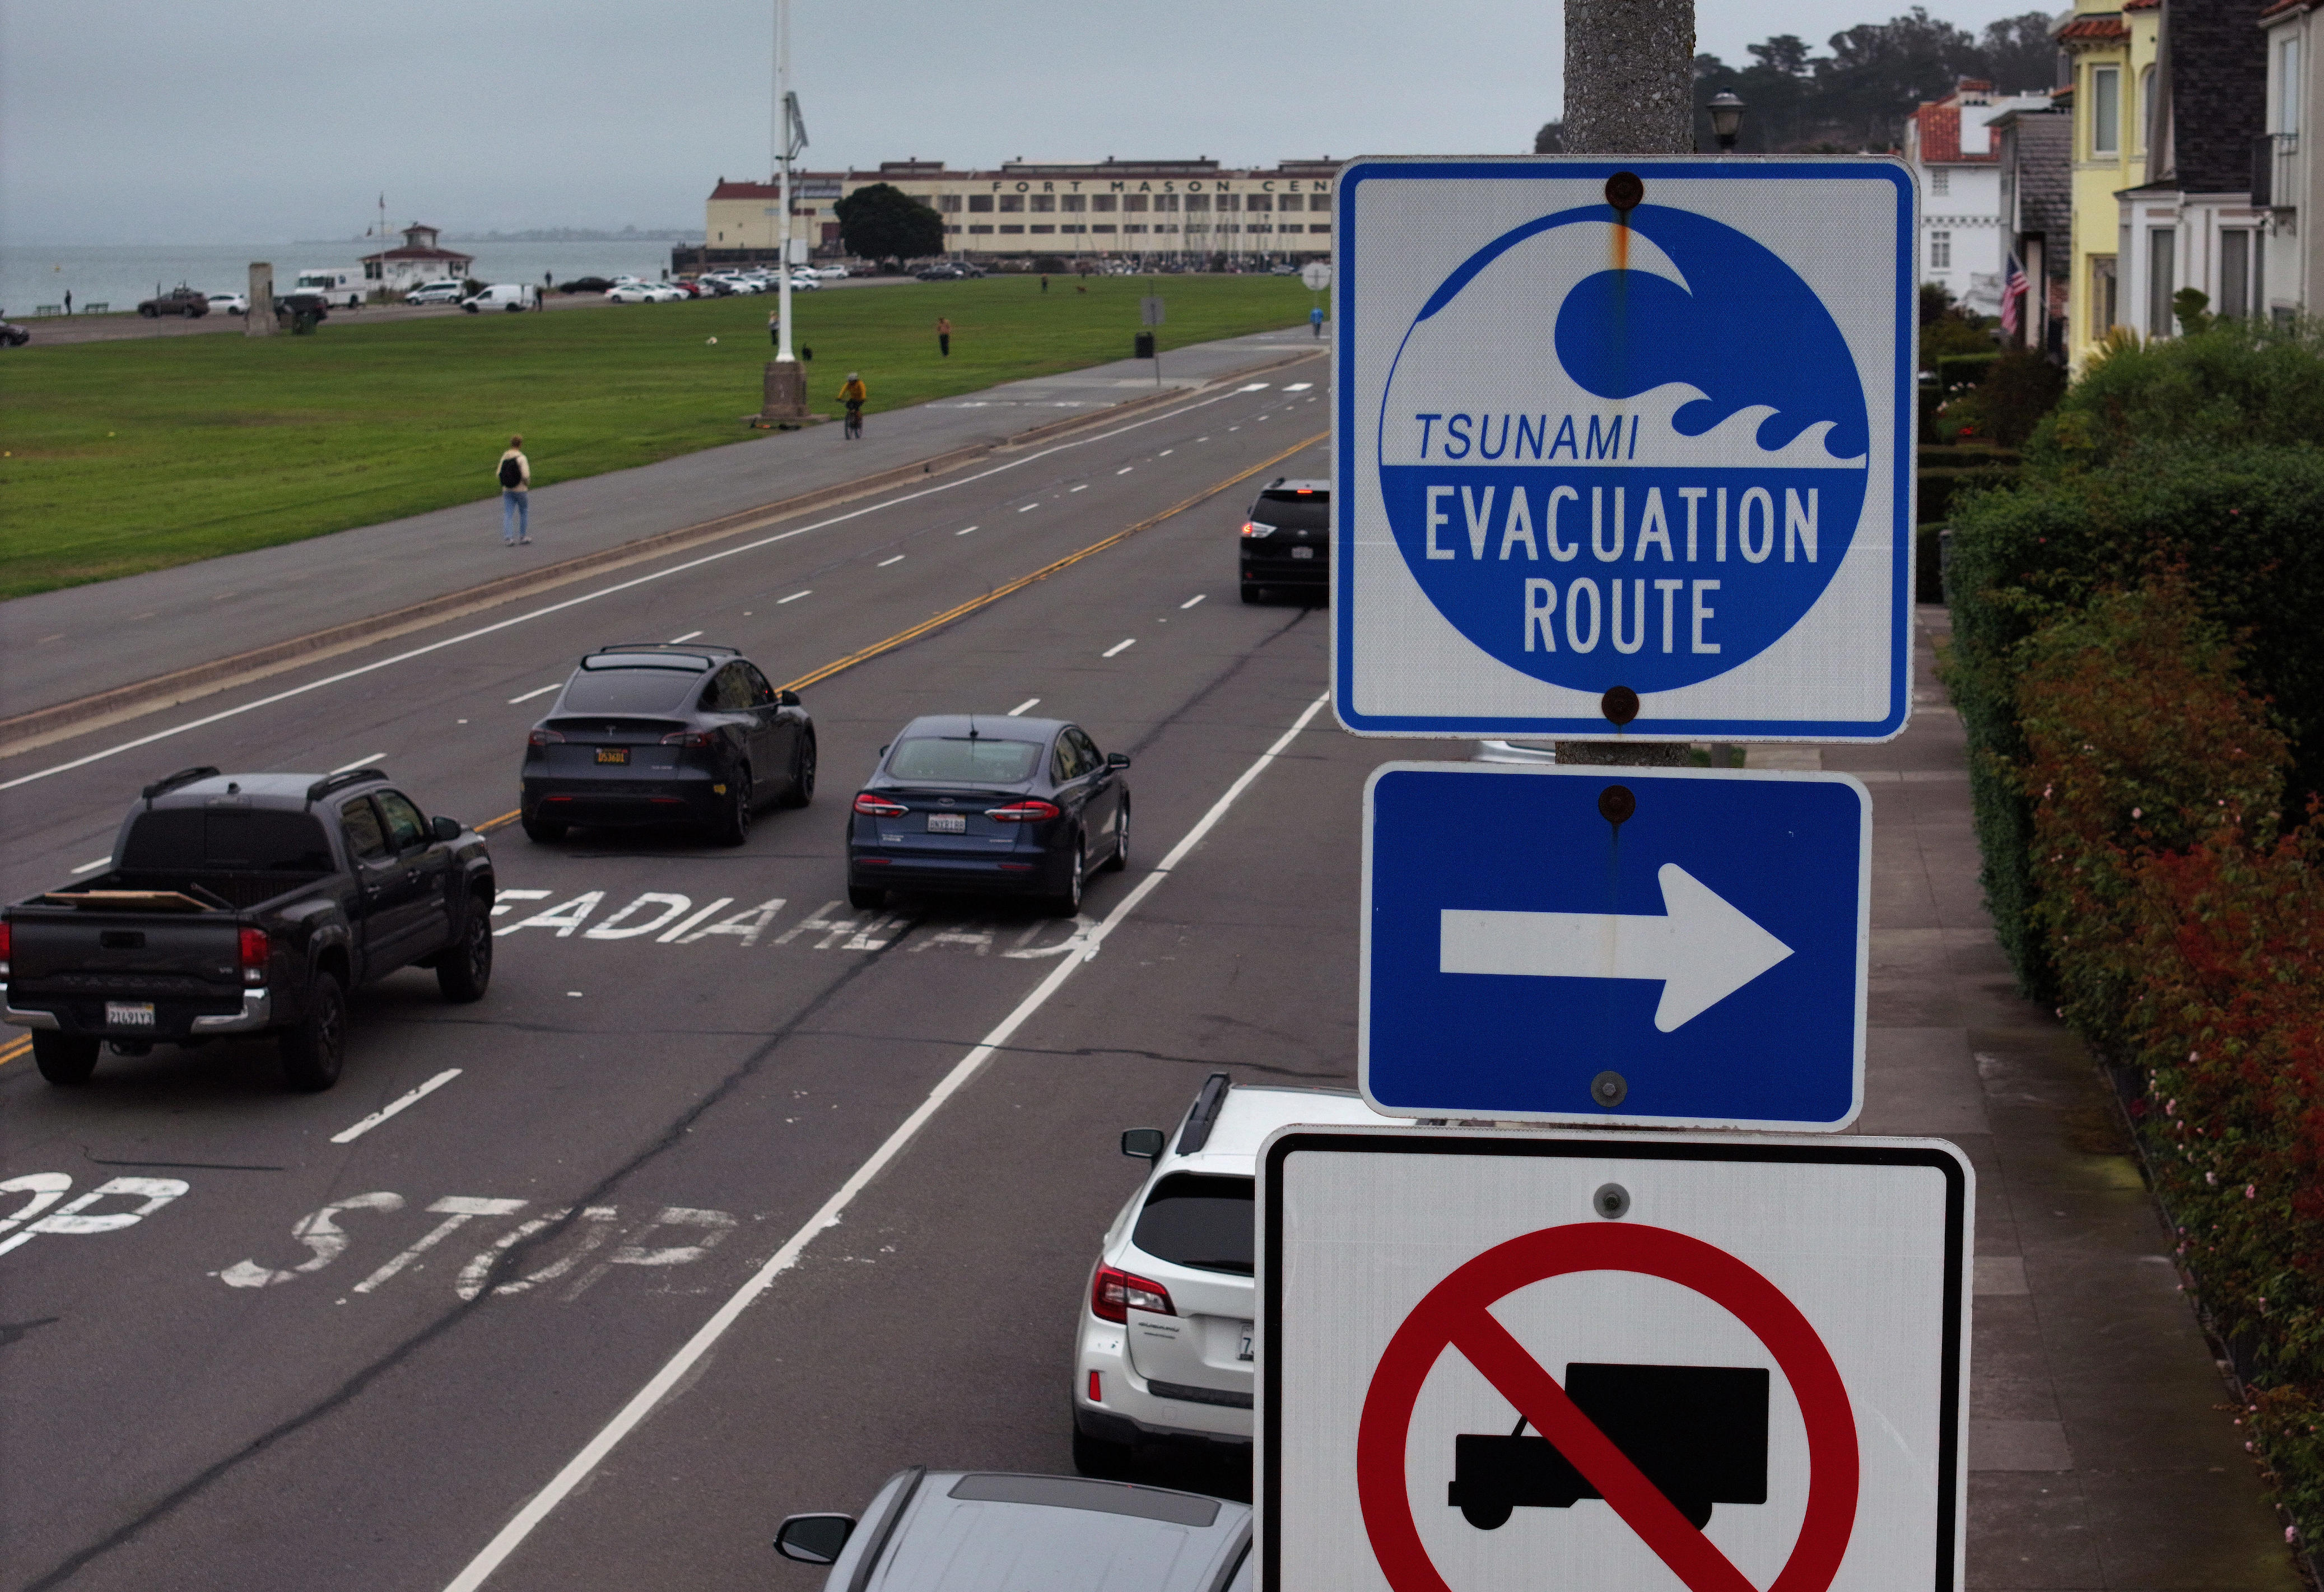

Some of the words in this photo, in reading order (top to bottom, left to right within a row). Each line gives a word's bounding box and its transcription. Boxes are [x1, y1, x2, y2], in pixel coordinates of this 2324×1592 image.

[992, 181, 1082, 193] FORT
[1110, 180, 1230, 193] MASON
[1415, 413, 1638, 460] TSUNAMI
[1426, 485, 1819, 564] EVACUATION
[1524, 577, 1721, 654] ROUTE
[220, 1190, 738, 1303] STOP
